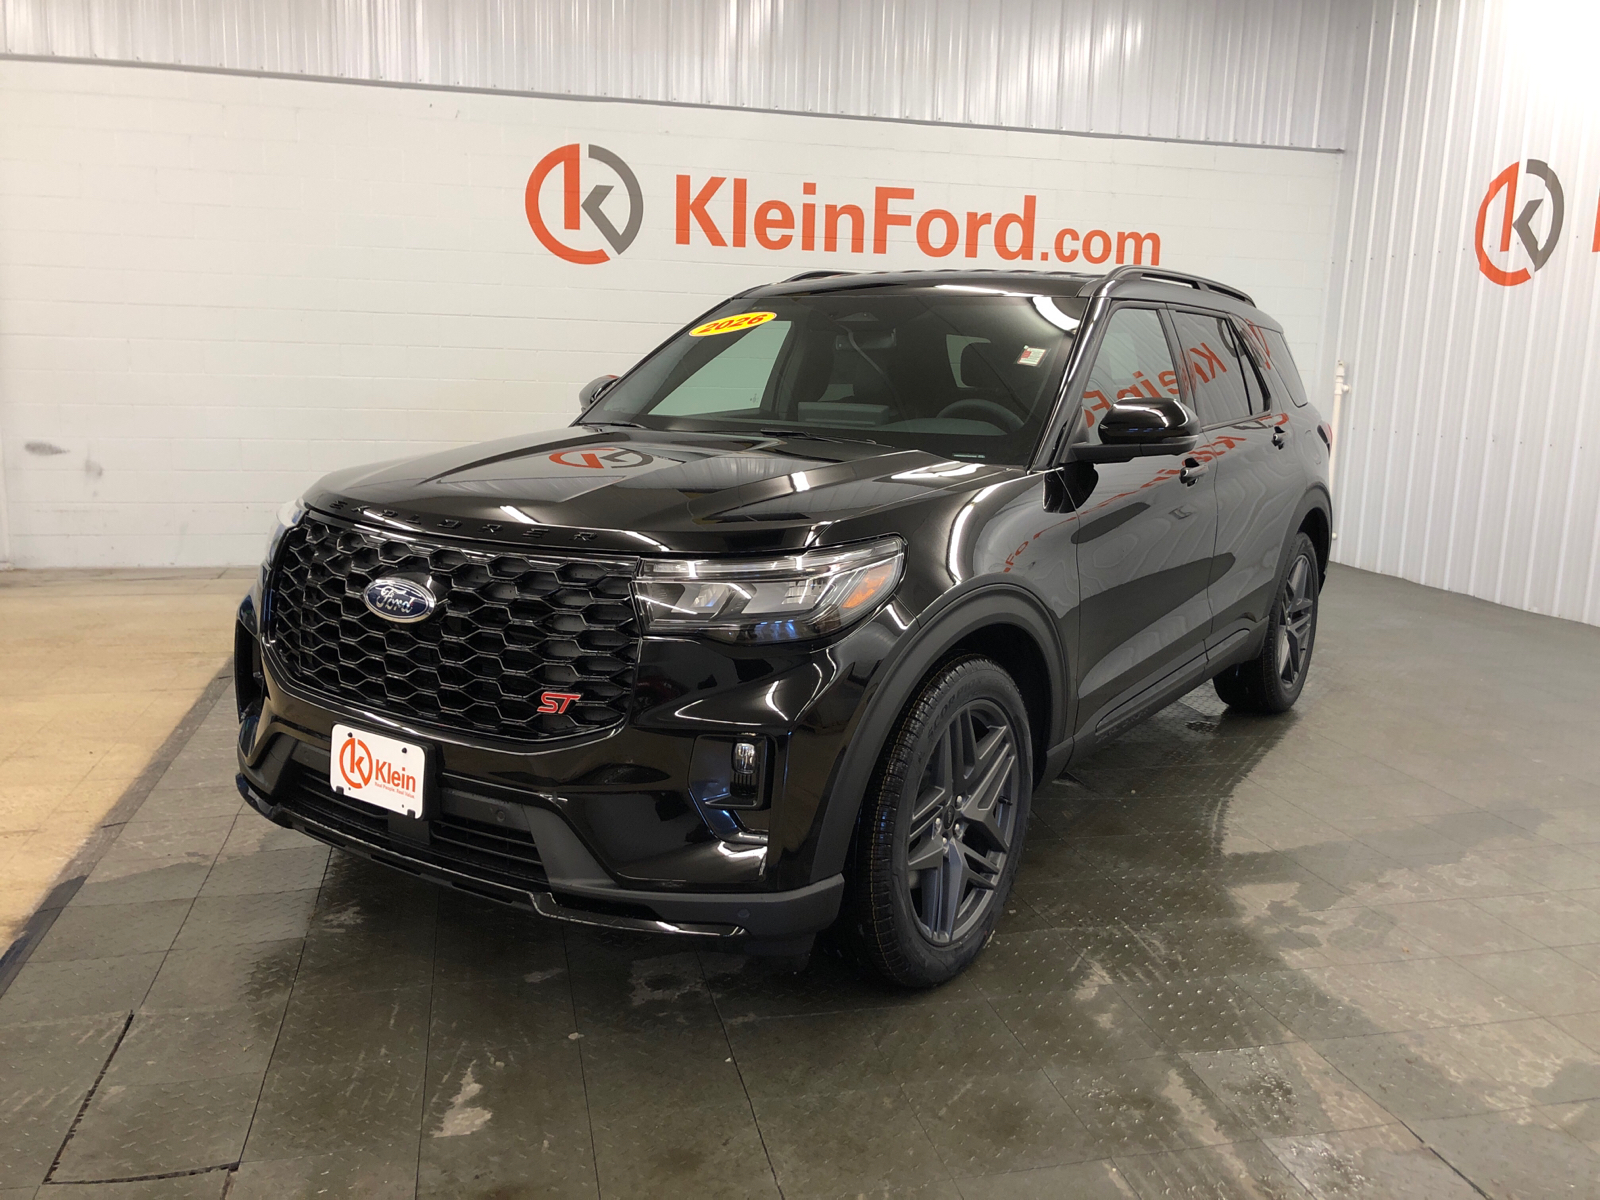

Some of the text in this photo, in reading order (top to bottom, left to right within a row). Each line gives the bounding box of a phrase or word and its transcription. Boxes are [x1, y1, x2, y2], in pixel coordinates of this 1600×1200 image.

[675, 174, 1161, 266] KleinFord.com
[696, 313, 768, 334] 2026
[328, 499, 597, 541] EXPLORER
[375, 585, 415, 614] Ford
[537, 692, 581, 714] ST
[375, 758, 416, 793] Klein
